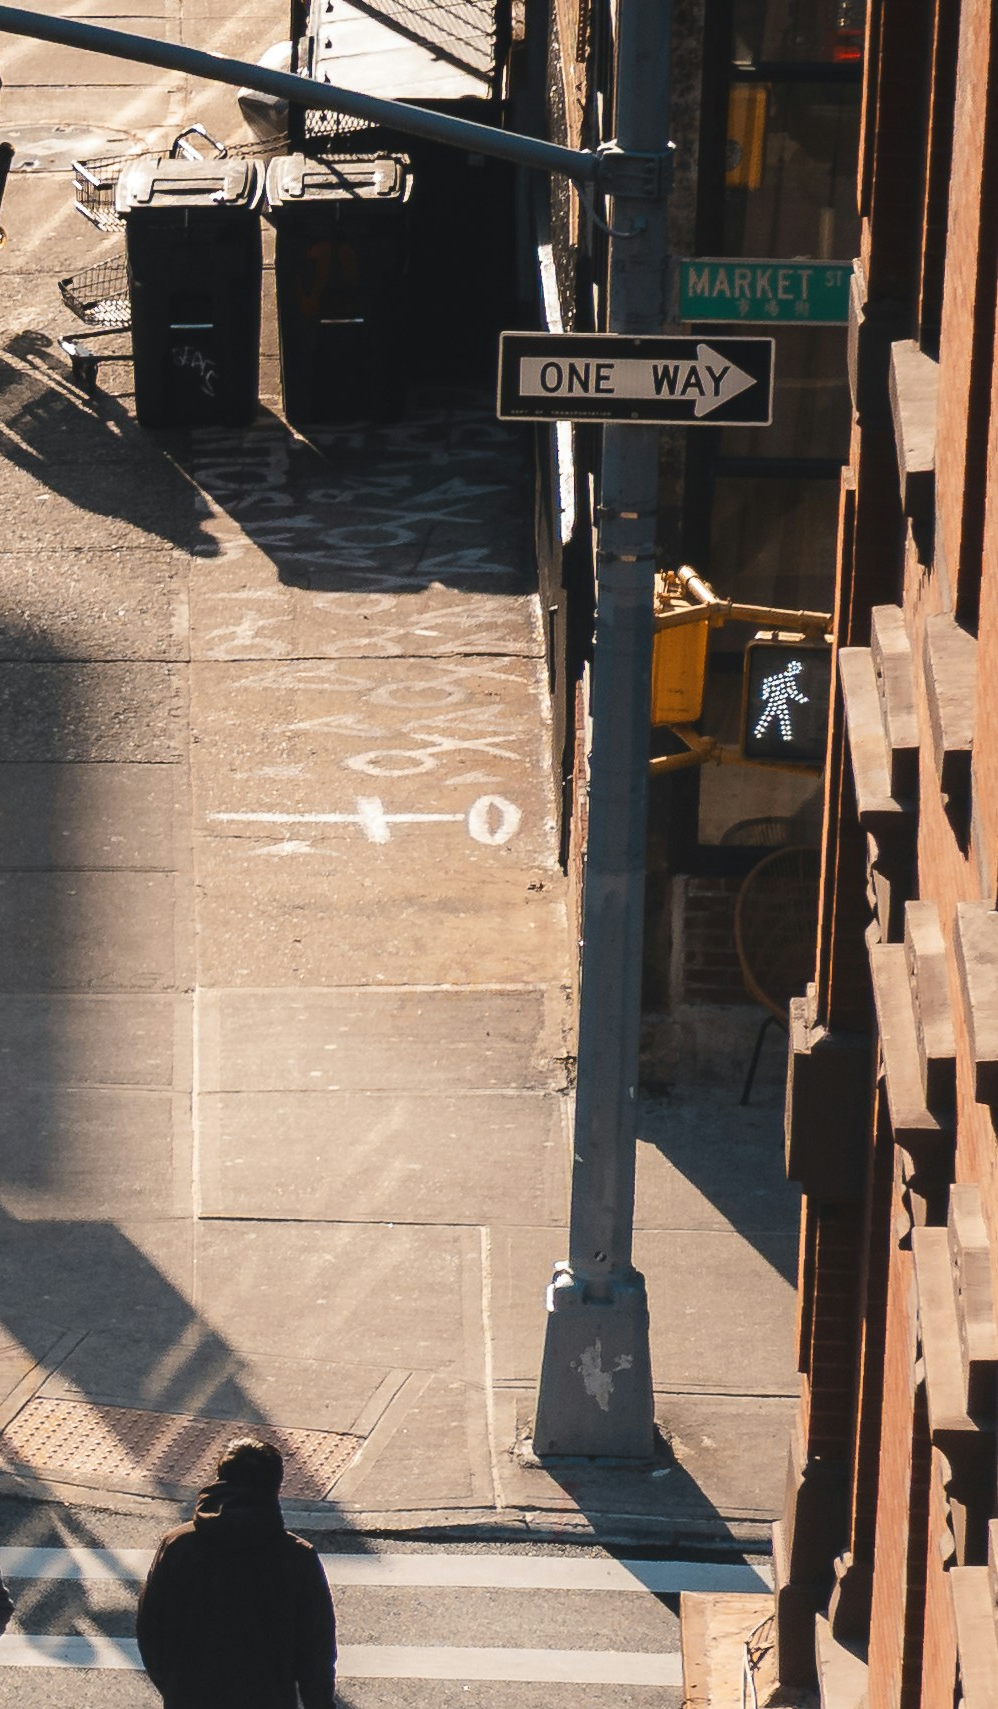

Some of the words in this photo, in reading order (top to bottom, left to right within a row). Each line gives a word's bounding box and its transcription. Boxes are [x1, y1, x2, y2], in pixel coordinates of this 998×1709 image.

[688, 267, 814, 300] MARKET
[825, 271, 844, 287] ST
[539, 362, 615, 394] ONE
[652, 364, 732, 397] WAY
